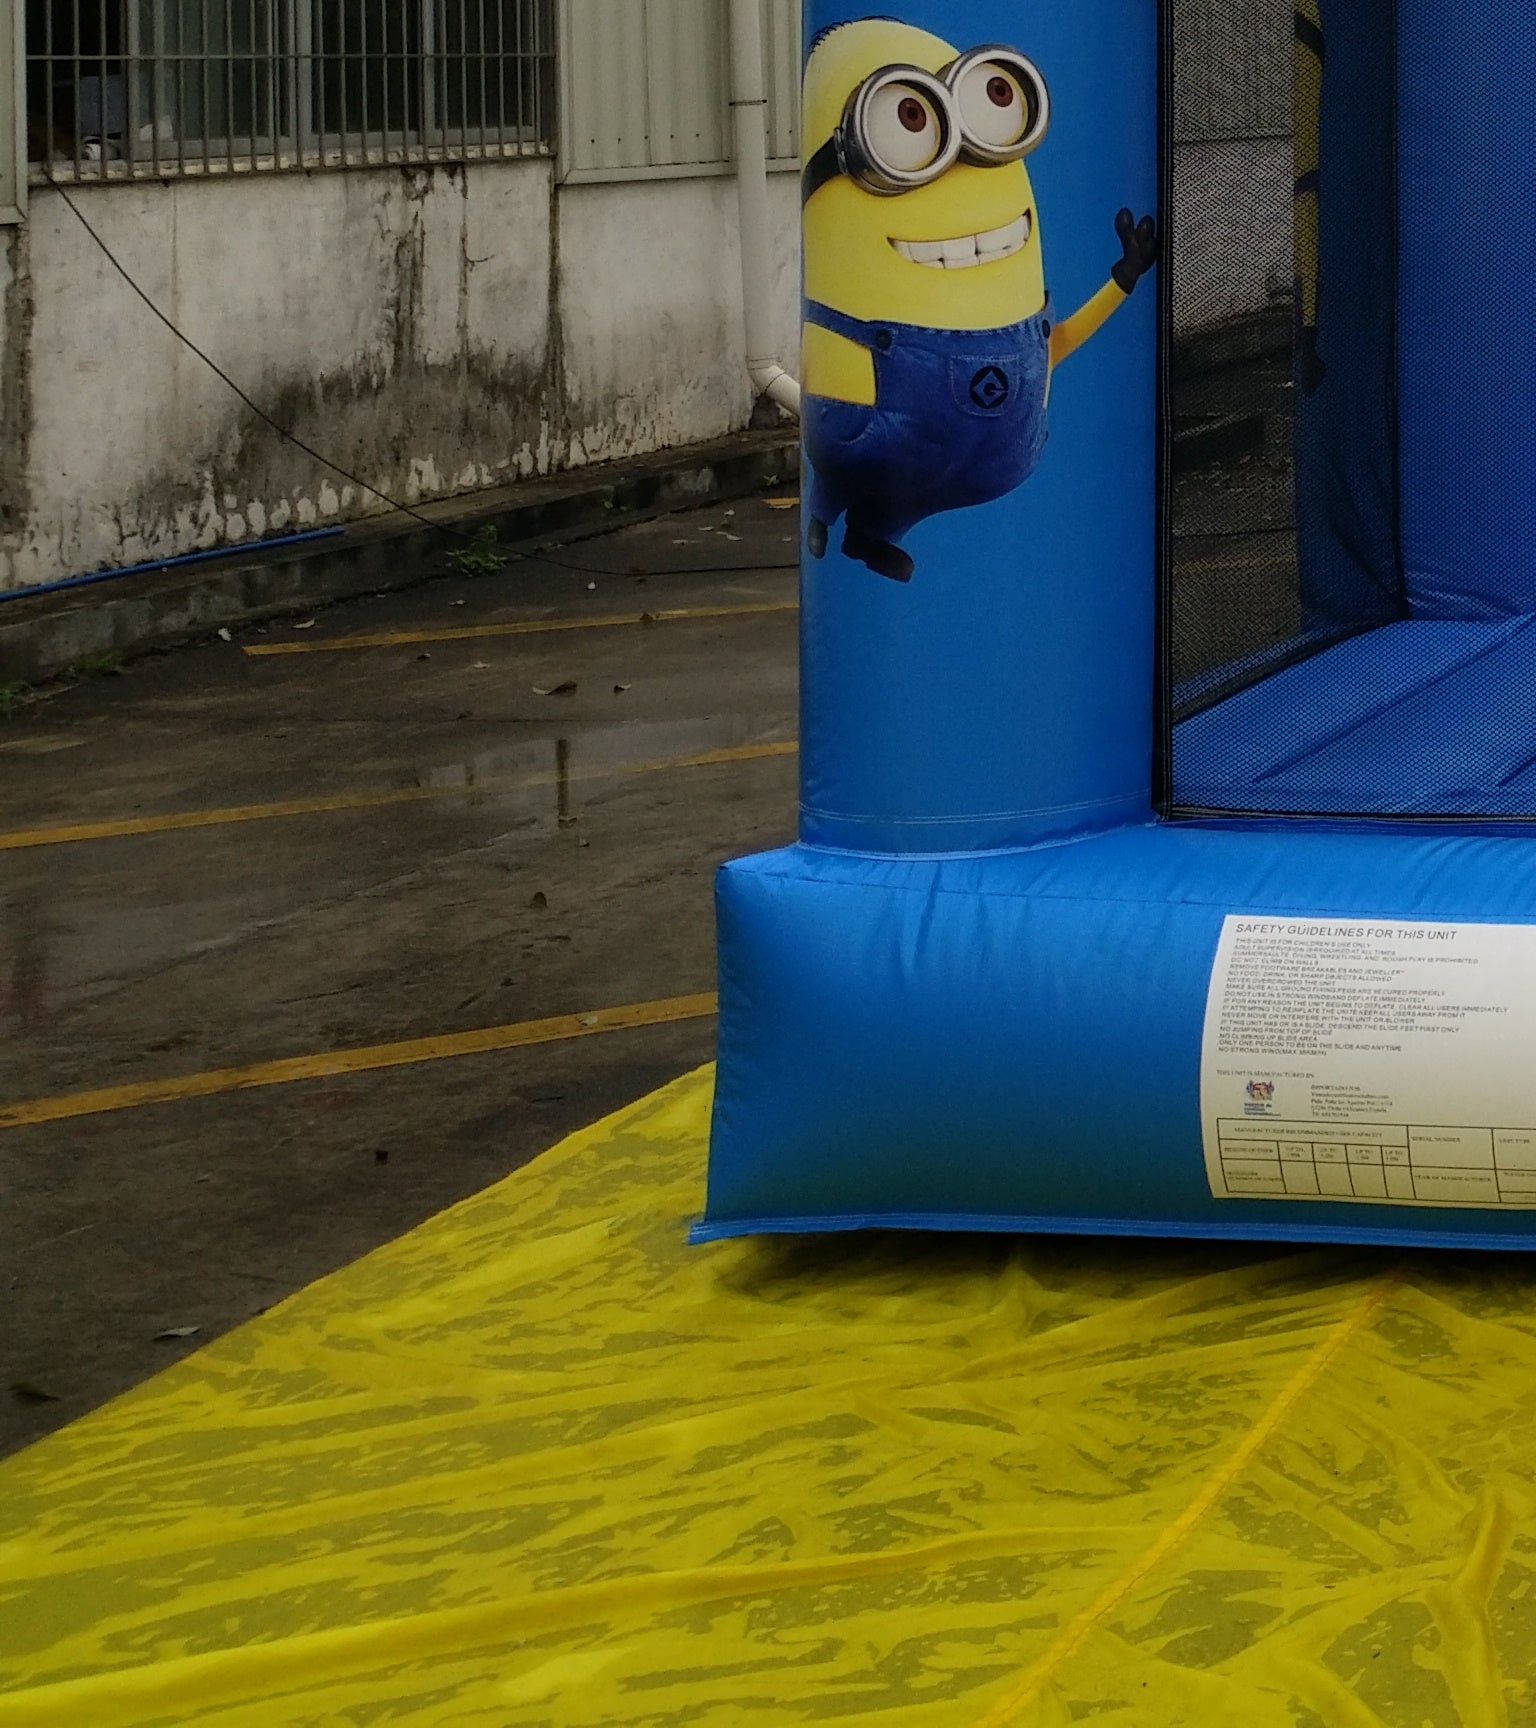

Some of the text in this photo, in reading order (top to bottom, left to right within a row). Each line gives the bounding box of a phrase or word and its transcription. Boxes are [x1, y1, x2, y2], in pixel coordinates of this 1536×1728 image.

[1236, 924, 1457, 940] SAFETY GUIDELINES FOR THIS UNIT
